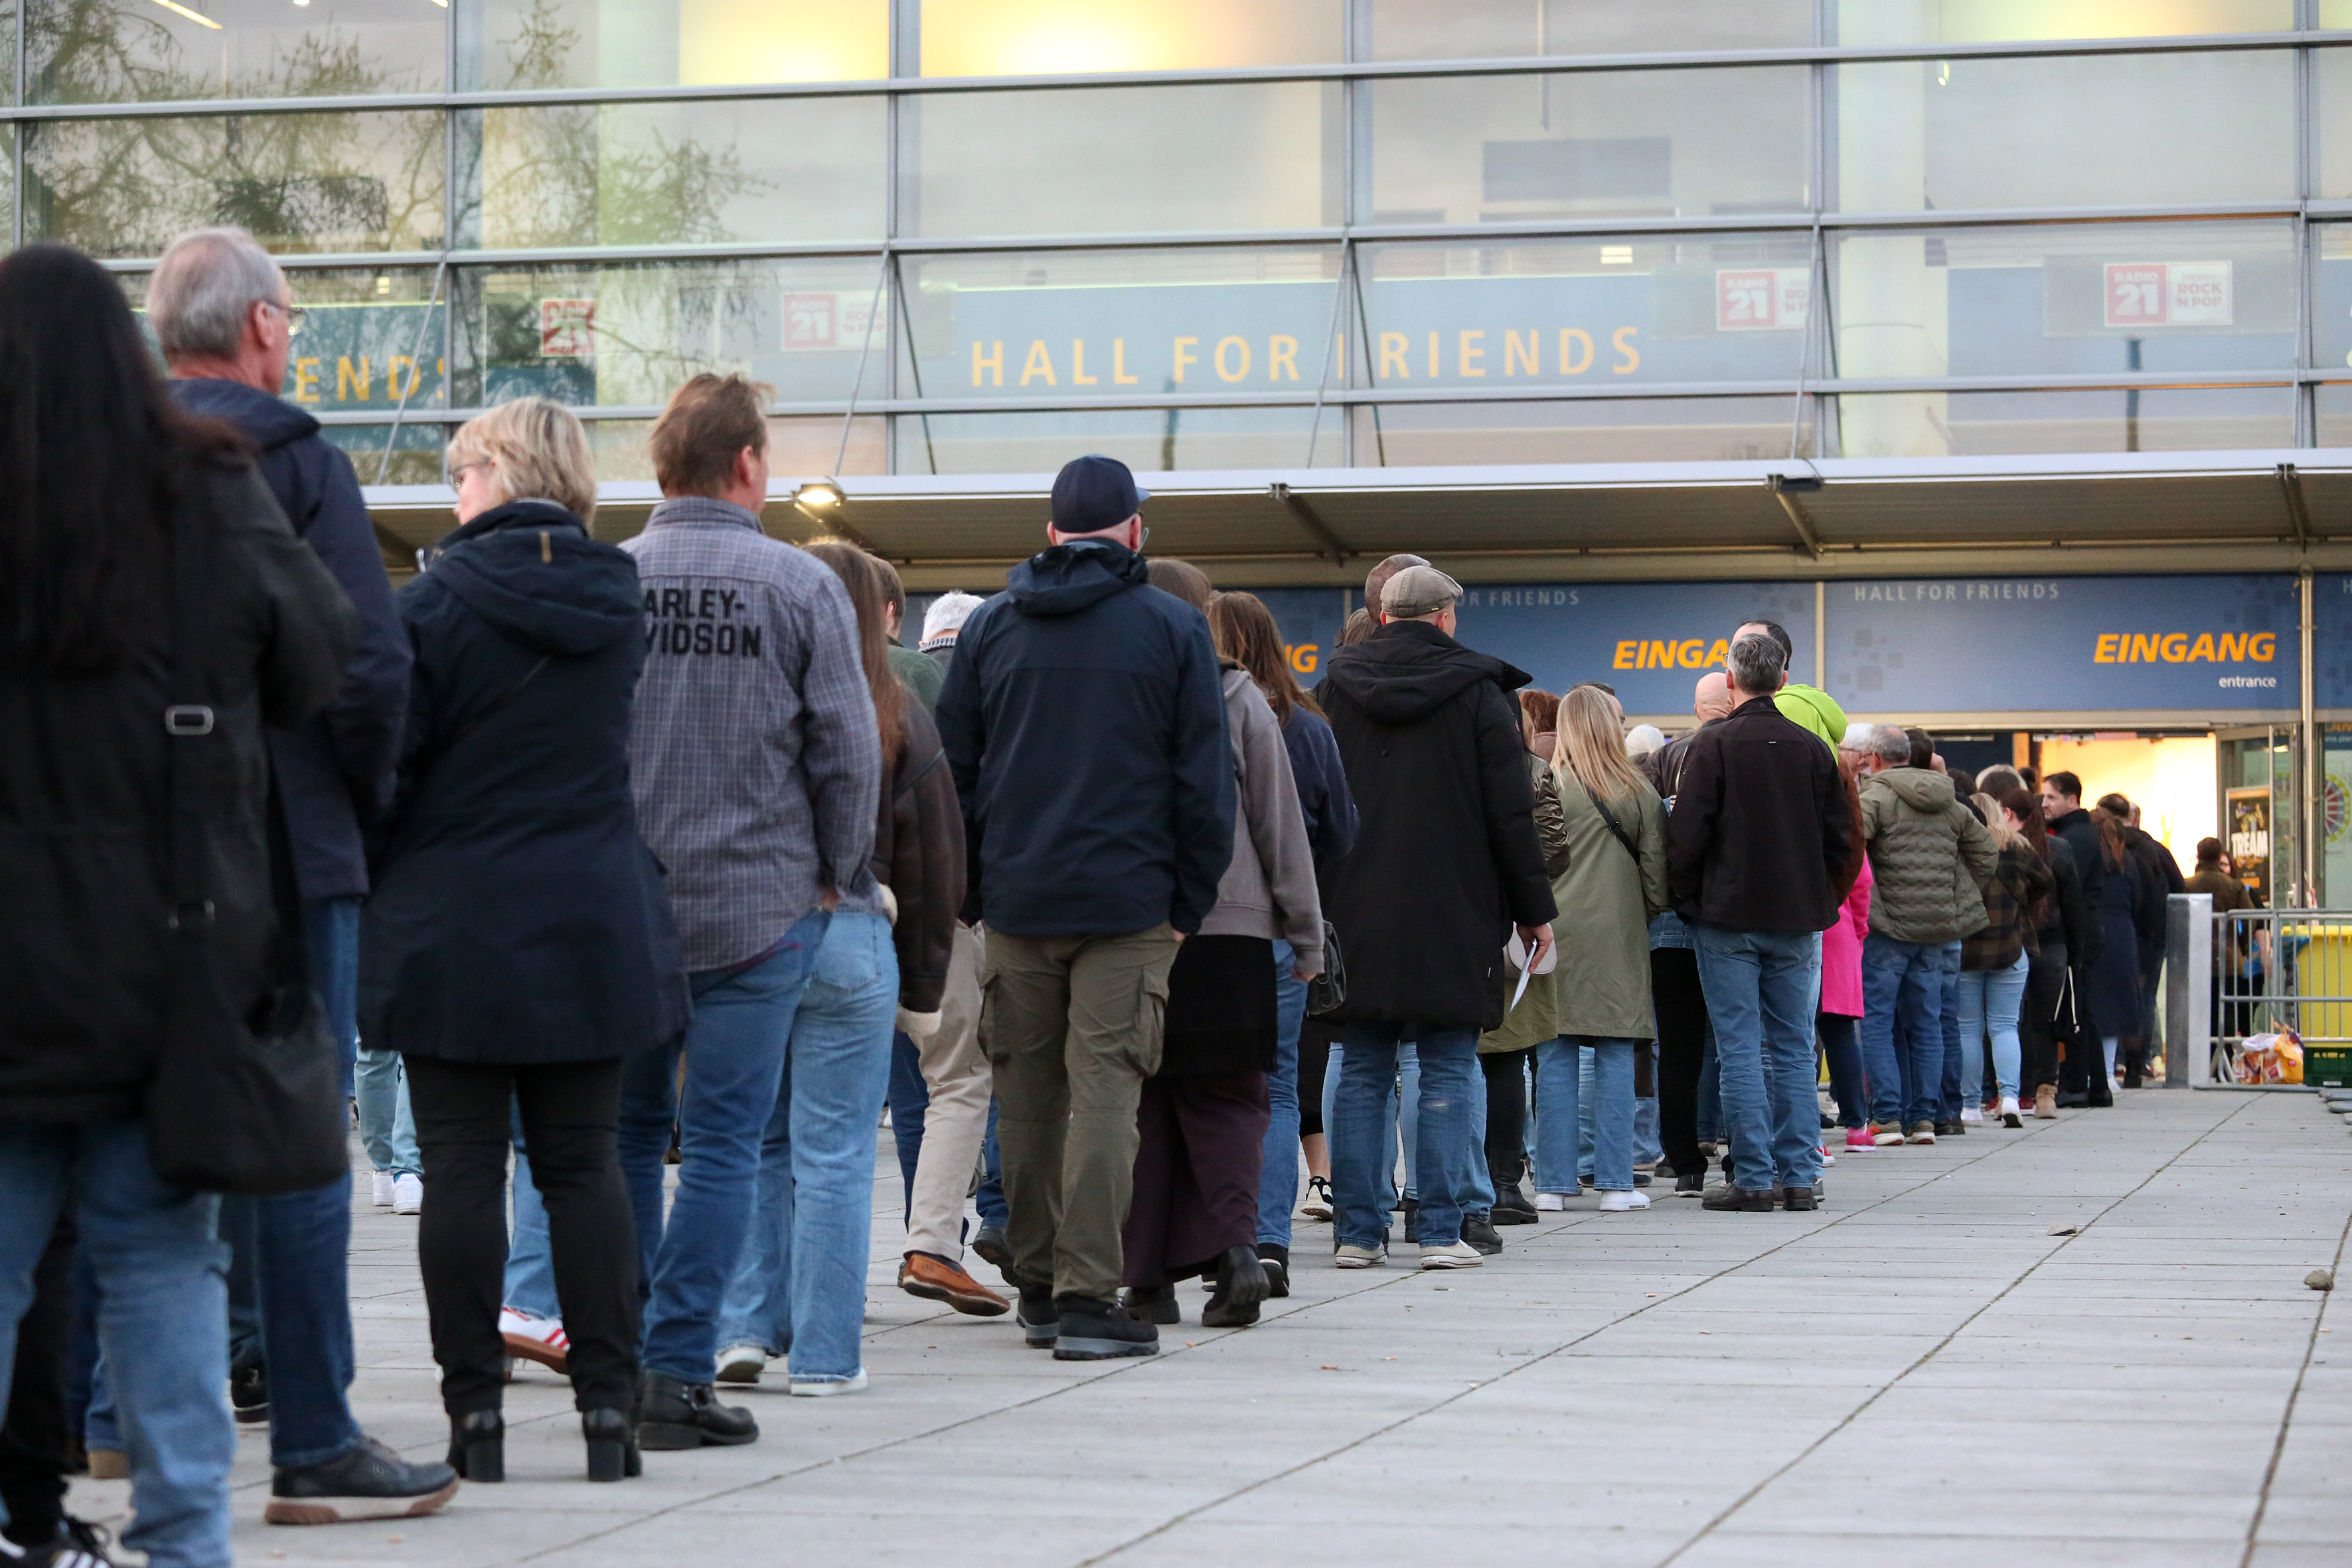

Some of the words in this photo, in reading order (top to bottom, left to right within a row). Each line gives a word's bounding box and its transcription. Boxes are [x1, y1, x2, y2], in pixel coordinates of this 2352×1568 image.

[2114, 272, 2159, 281] RADIO
[2115, 283, 2159, 315] 21
[2177, 283, 2223, 295] ROCK
[1727, 290, 1768, 320] 21
[2191, 297, 2223, 308] POP
[791, 311, 828, 341] 21
[972, 338, 1138, 387] HALL
[1173, 335, 1300, 384] FOR
[296, 355, 444, 402] END
[1489, 589, 1579, 606] FRIENDS
[1855, 586, 1906, 601] HALL
[1917, 584, 1956, 600] FOR
[1966, 583, 2059, 599] FRIENDS
[2094, 632, 2276, 663] EINGANG
[2218, 675, 2277, 688] entrance
